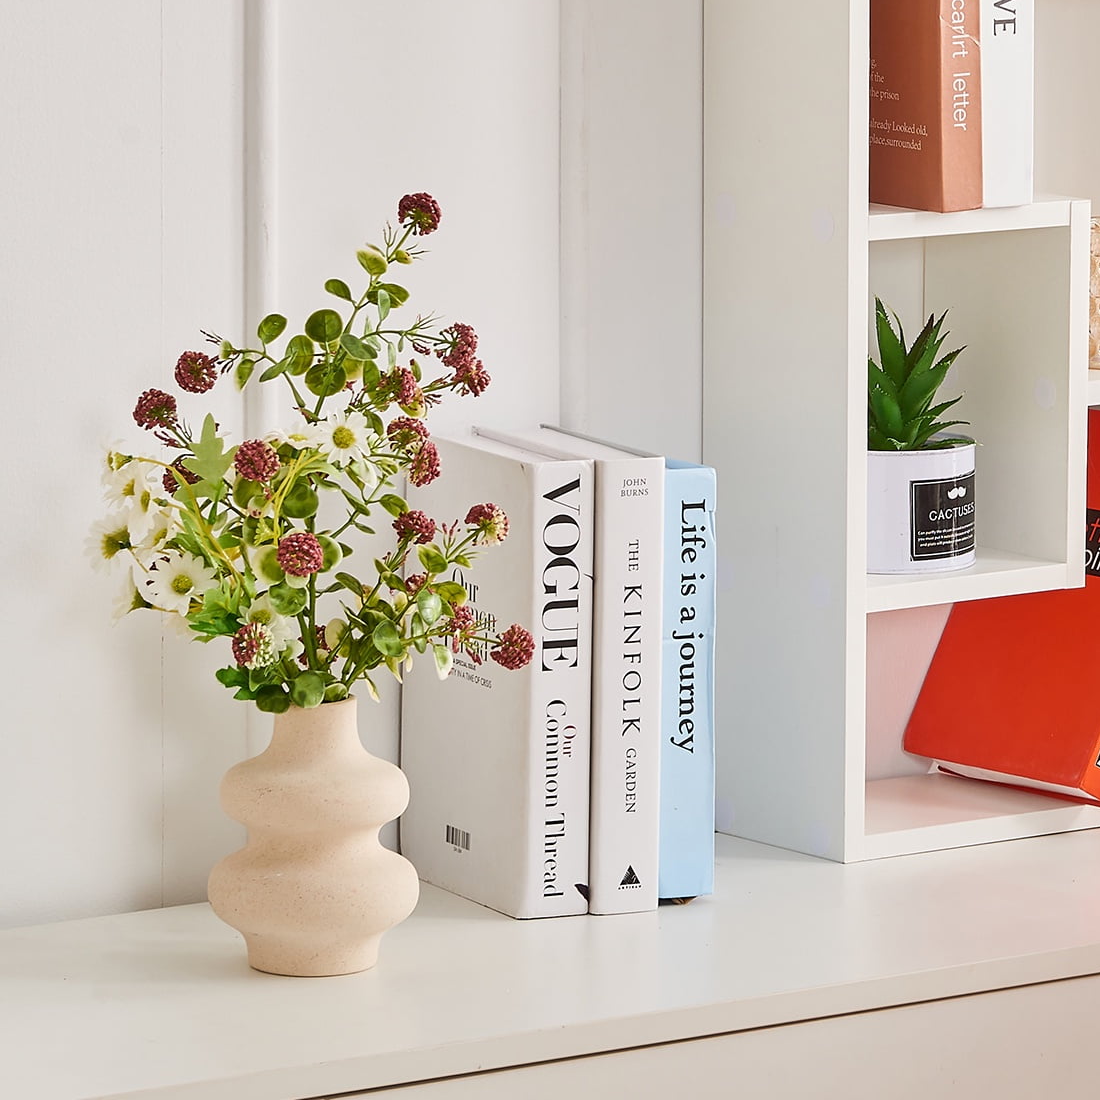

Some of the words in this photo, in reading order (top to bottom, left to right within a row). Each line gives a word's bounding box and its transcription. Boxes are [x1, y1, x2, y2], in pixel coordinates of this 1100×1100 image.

[871, 87, 879, 98] he
[879, 89, 900, 101] prison
[952, 72, 971, 131] letter
[892, 120, 916, 135] Looked
[620, 488, 649, 498] BURNS
[622, 477, 647, 488] JOHN
[929, 501, 975, 521] CACTUSES
[681, 499, 706, 564] Life
[628, 539, 639, 572] THE
[541, 473, 581, 672] VOGUE
[680, 572, 706, 597] is
[679, 606, 696, 625] a
[621, 584, 643, 737] KINFOLK
[670, 629, 704, 754] journey
[545, 699, 567, 808] Common
[563, 725, 577, 758] Our
[625, 747, 637, 814] GARDEN
[543, 812, 566, 898] Thread
